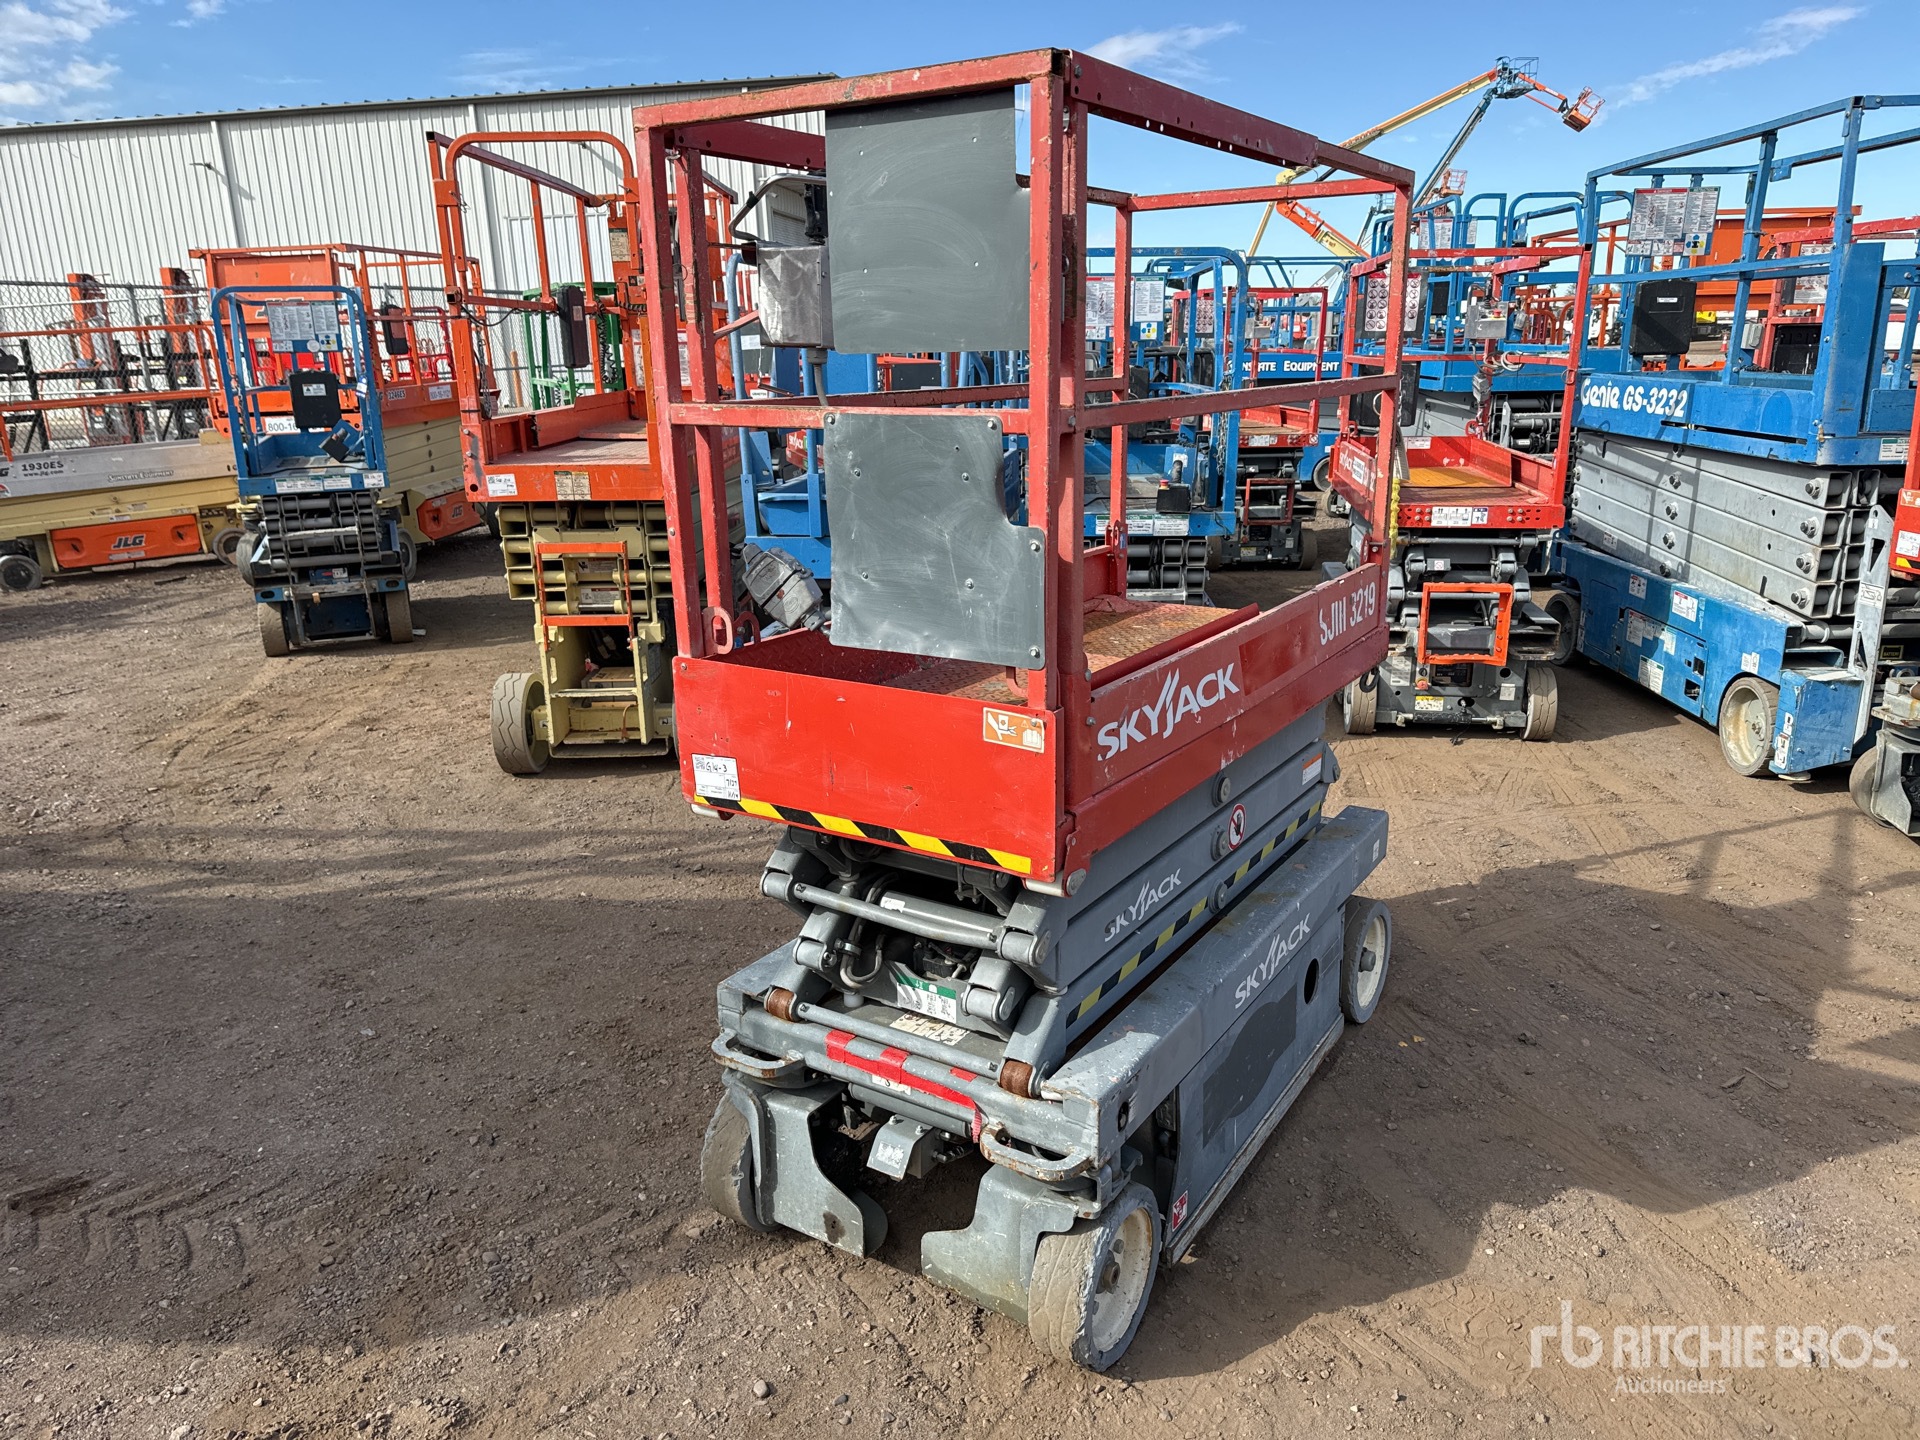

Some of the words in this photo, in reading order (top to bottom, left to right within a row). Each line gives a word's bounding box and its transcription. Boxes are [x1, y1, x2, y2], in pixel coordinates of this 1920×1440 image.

[1581, 378, 1620, 409] Genie
[1622, 385, 1688, 417] GS-3232
[21, 460, 64, 472] 1930ES
[113, 534, 145, 549] JLG
[1350, 581, 1376, 627] 3219
[1097, 663, 1240, 761] SKYJACK
[1104, 868, 1182, 943] SKYJACK
[1235, 912, 1311, 1009] SKYJACK
